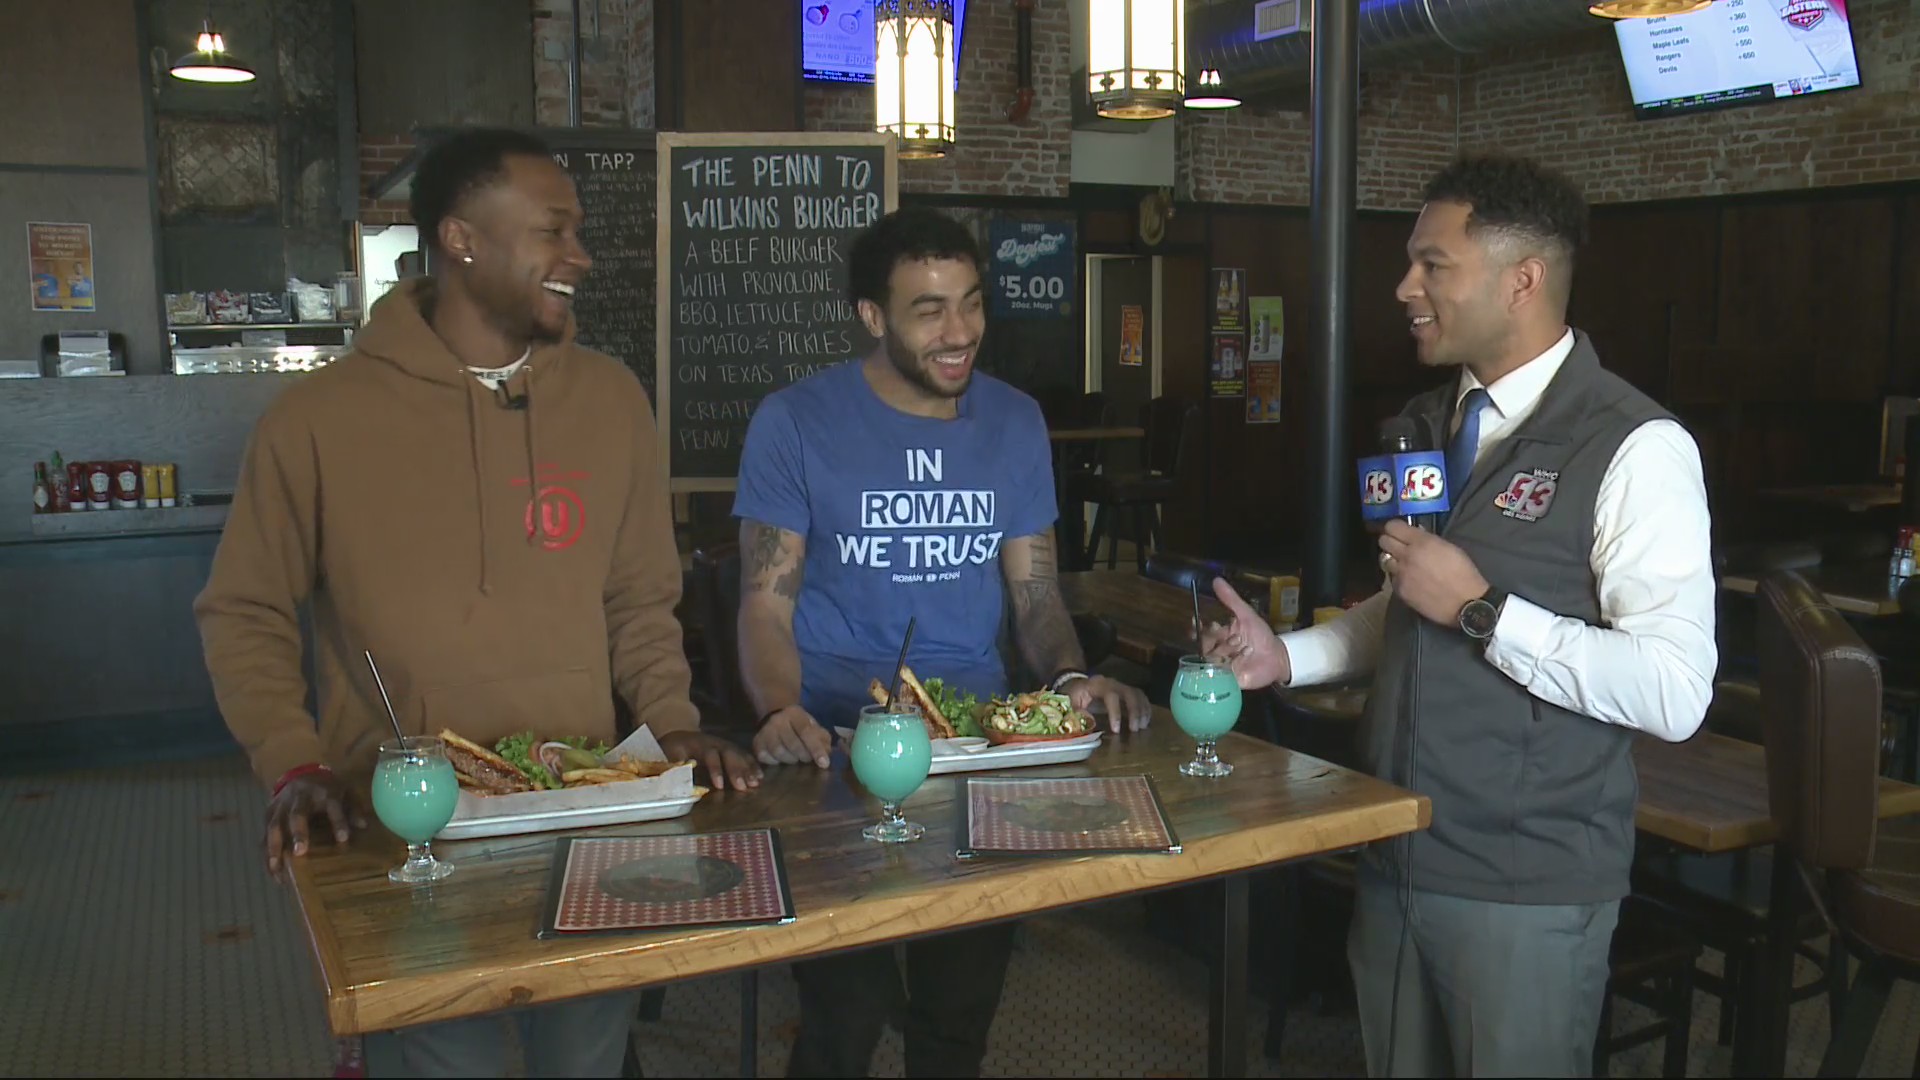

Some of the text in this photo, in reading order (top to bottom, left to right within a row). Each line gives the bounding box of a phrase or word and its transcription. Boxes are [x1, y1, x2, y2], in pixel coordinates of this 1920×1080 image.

[1782, 1, 1828, 18] EASTERN
[1650, 12, 1747, 37] Hurricanes +360
[1653, 25, 1750, 49] Maple Leafs +550
[1656, 38, 1753, 63] Rangers +550
[1658, 51, 1756, 74] Devils +650
[585, 152, 635, 170] TAP?
[682, 153, 872, 190] THE PENN TO
[682, 191, 880, 231] WILKINS BURGER
[684, 235, 844, 266] A BEEF BURGER
[680, 268, 841, 297] WITH PROVOLONE,
[1000, 275, 1064, 299] $5.00
[1033, 301, 1053, 310] Mugs
[778, 330, 852, 356] PICKLES
[678, 365, 707, 384] ON
[718, 363, 773, 384] TEXAS
[679, 428, 730, 450] PENN
[906, 449, 943, 482] IN
[1404, 464, 1444, 499] 13
[865, 493, 992, 525] ROMAN
[836, 531, 1003, 568] WE TRUST
[892, 571, 961, 583] ROMAN PENN
